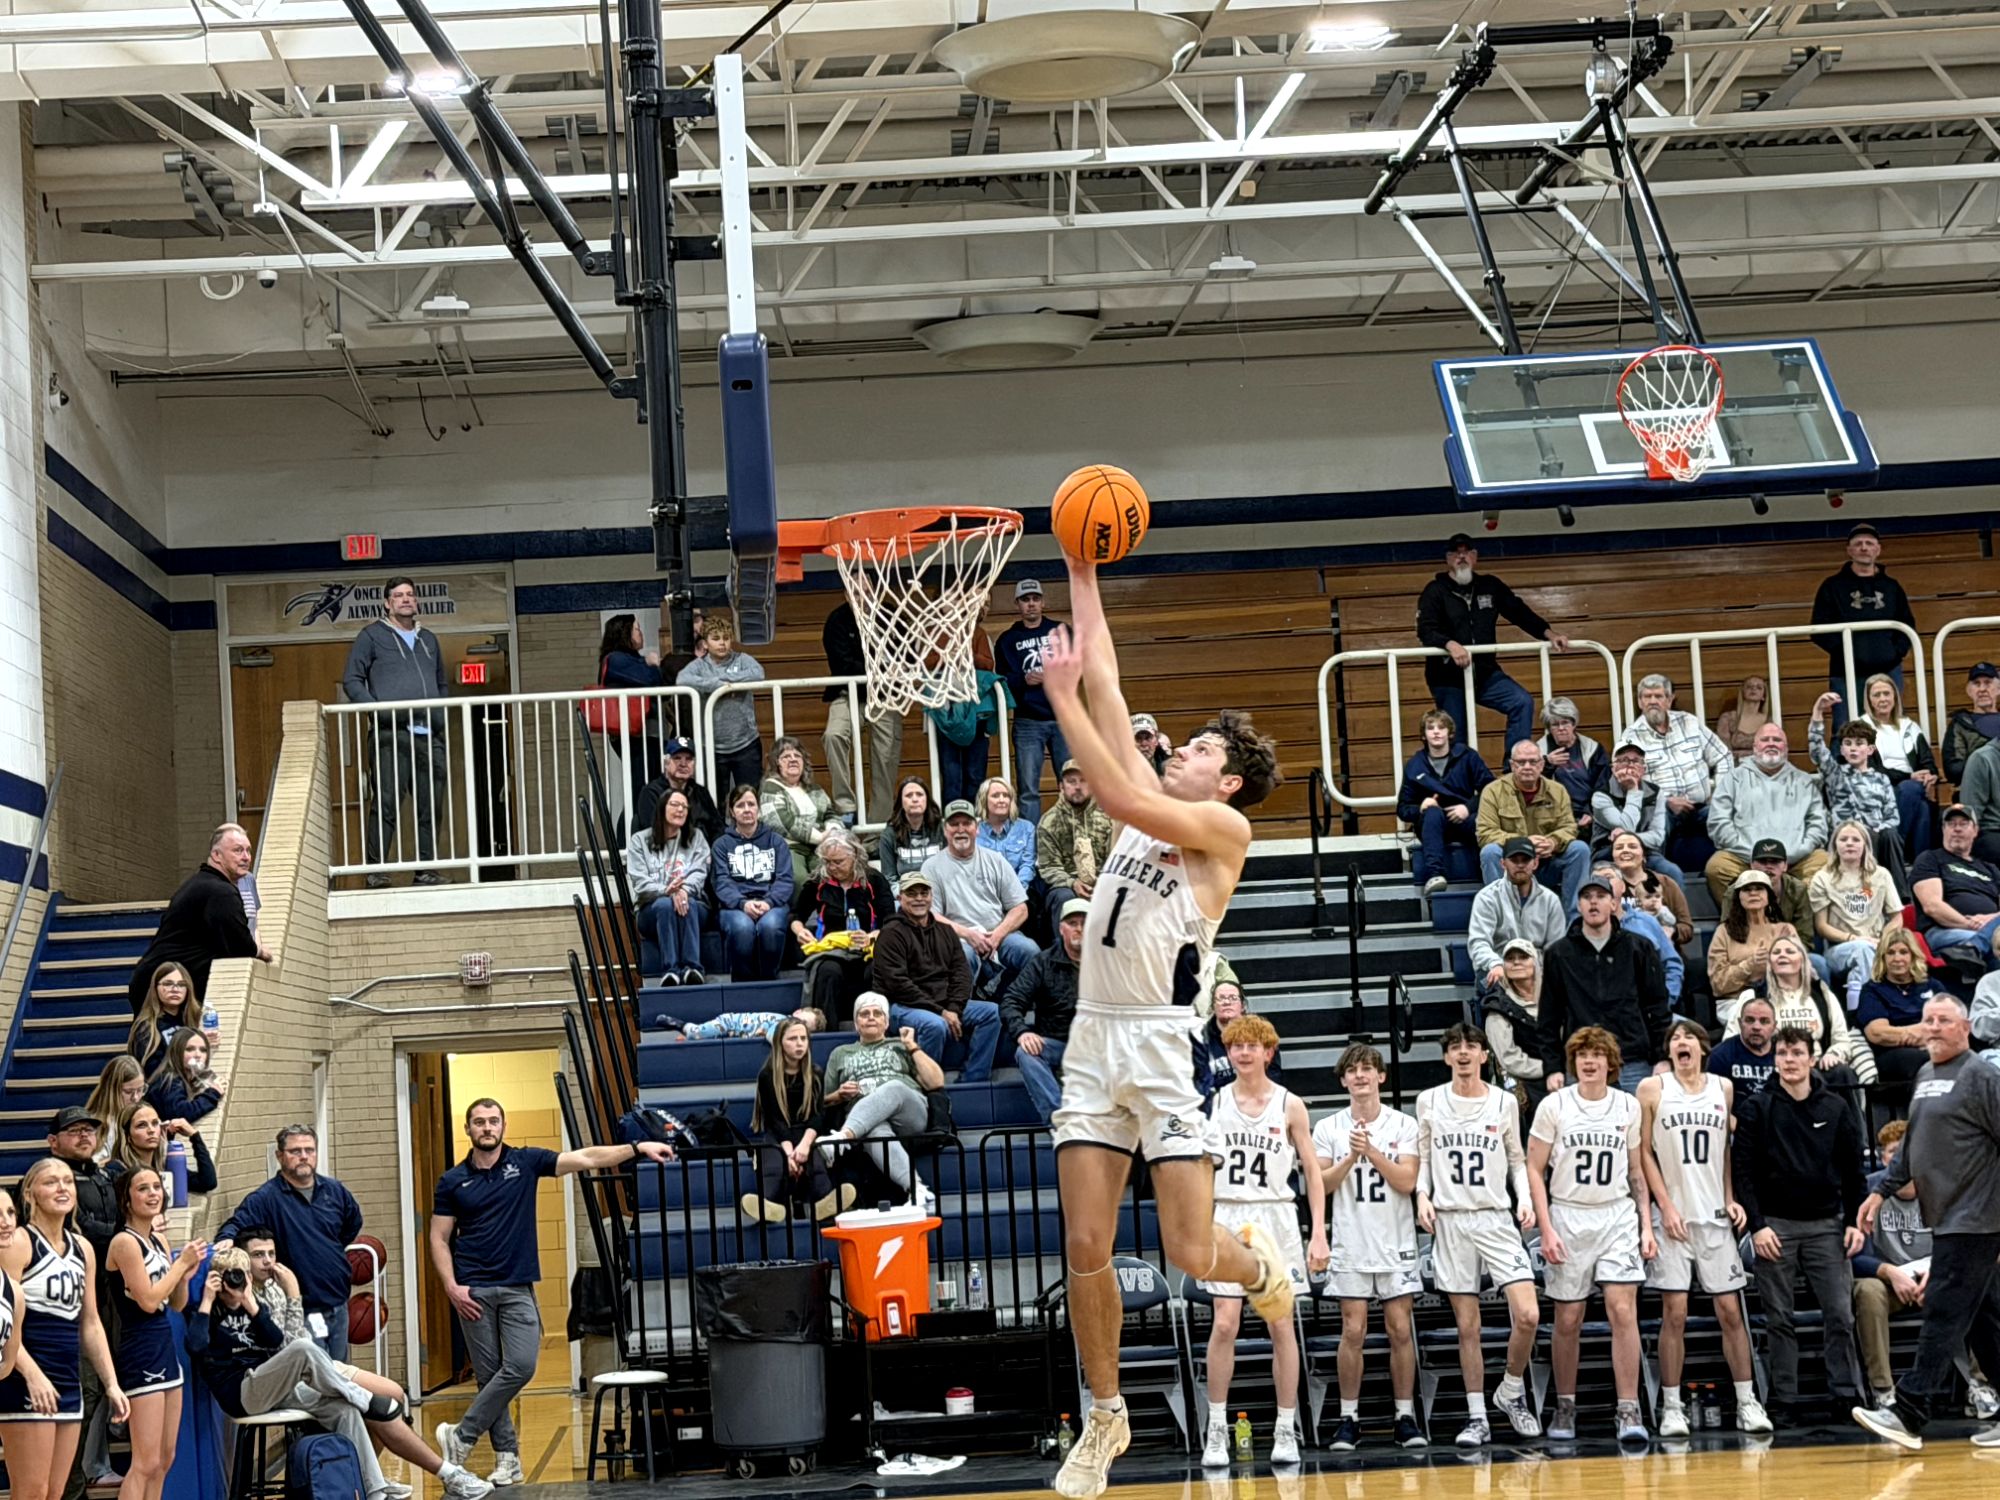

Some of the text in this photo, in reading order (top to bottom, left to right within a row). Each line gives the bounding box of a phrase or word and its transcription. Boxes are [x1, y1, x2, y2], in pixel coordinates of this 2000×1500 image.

[353, 583, 448, 601] ONCE ALIER
[416, 600, 456, 616] VALIER
[461, 663, 486, 683] EXIT
[1101, 886, 1129, 949] 1
[1225, 1132, 1283, 1155] AVALIERS
[1434, 1132, 1499, 1152] CAVALIERS
[1680, 1129, 1710, 1165] 10
[1228, 1149, 1268, 1188] 24
[1448, 1150, 1485, 1187] 32
[1575, 1149, 1614, 1186] 20
[1354, 1166, 1386, 1203] 12
[1114, 1267, 1155, 1292] VS
[1239, 1437, 1250, 1449] G
